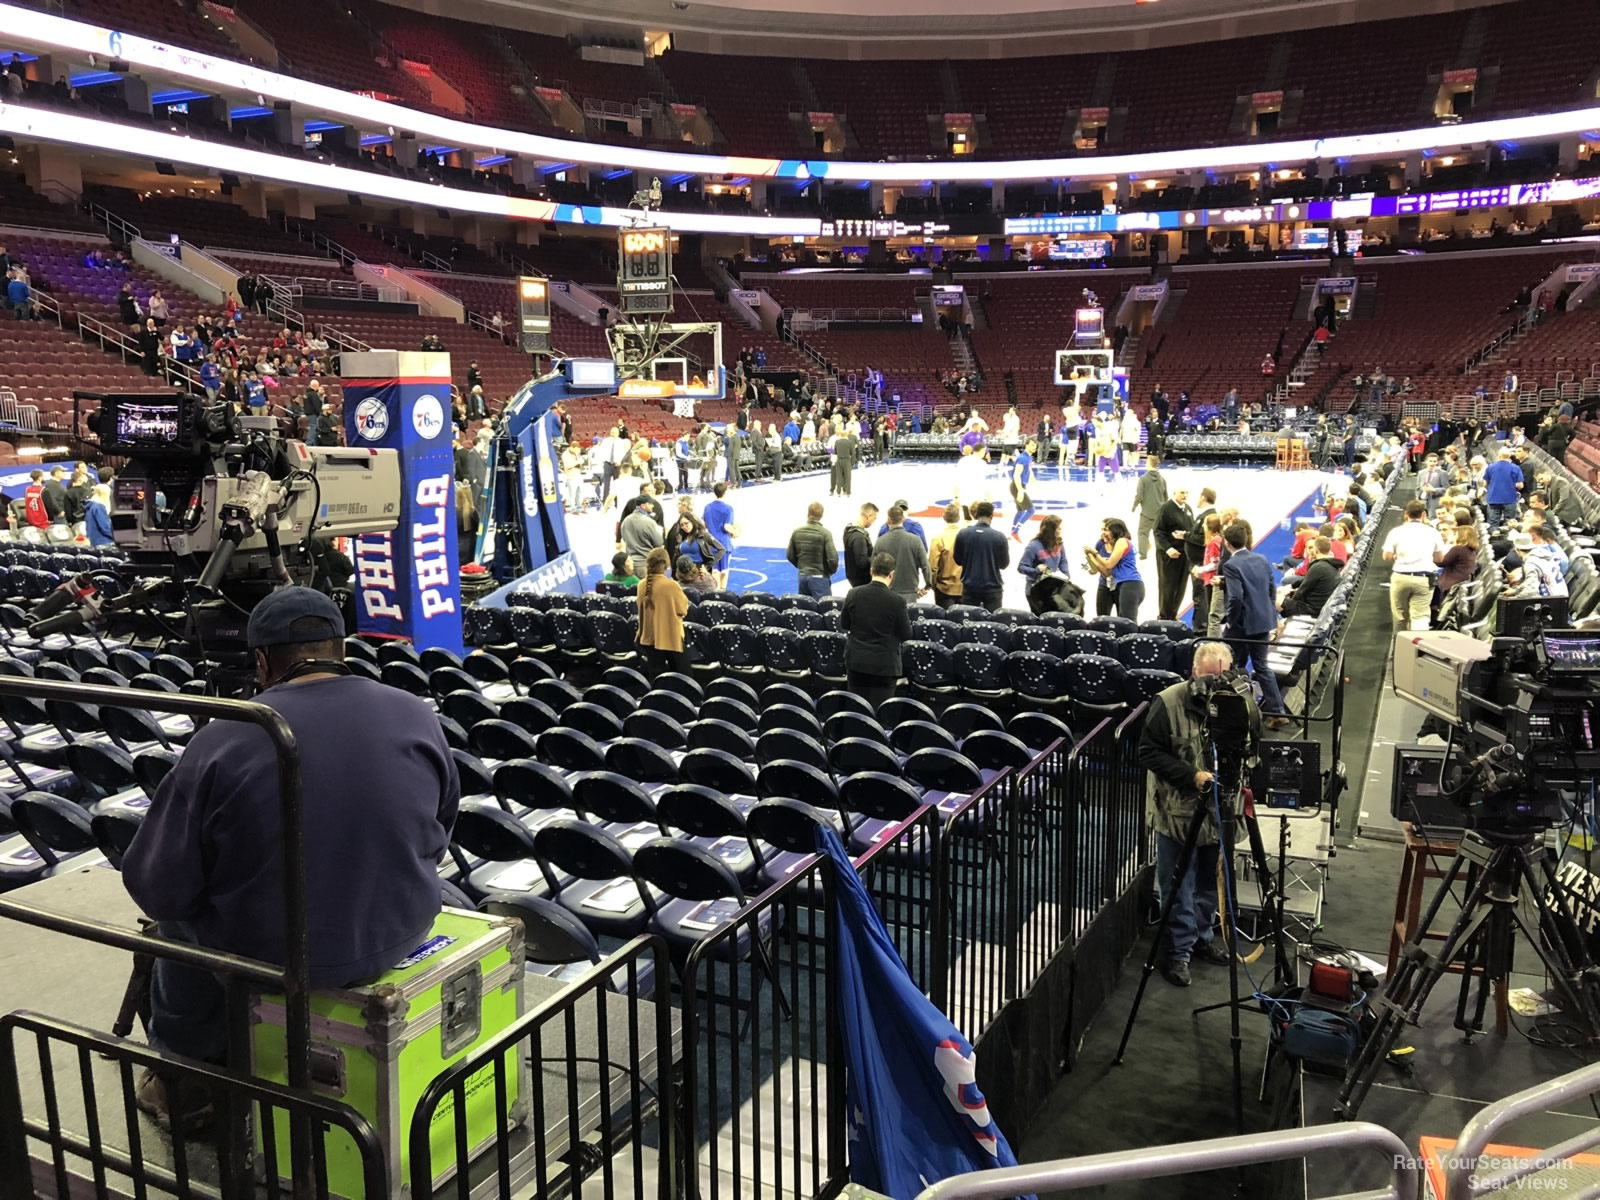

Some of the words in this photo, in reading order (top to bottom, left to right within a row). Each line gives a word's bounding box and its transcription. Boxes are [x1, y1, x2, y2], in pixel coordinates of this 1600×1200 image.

[137, 491, 145, 500] 3
[29, 497, 40, 512] 4
[413, 474, 456, 619] PHILA
